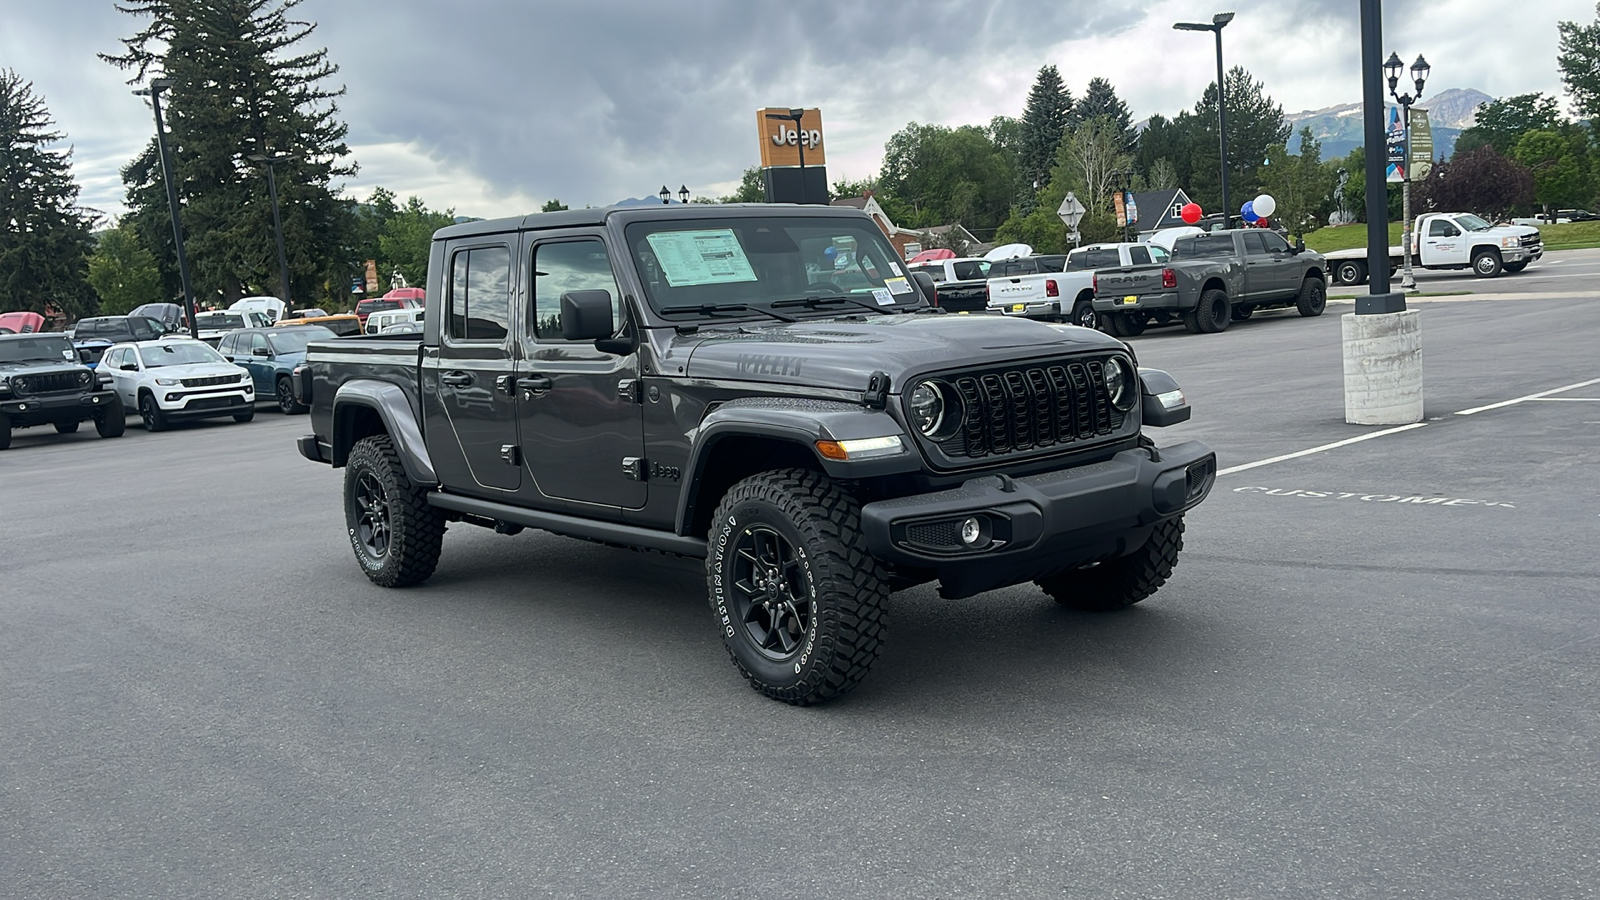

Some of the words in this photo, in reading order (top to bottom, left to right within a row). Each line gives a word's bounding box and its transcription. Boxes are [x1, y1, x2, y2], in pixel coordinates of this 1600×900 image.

[772, 124, 821, 149] Jeep
[1111, 275, 1147, 283] RAM
[736, 353, 808, 377] WILLYS
[650, 461, 681, 482] Jeep
[713, 522, 735, 638] DESTINATION
